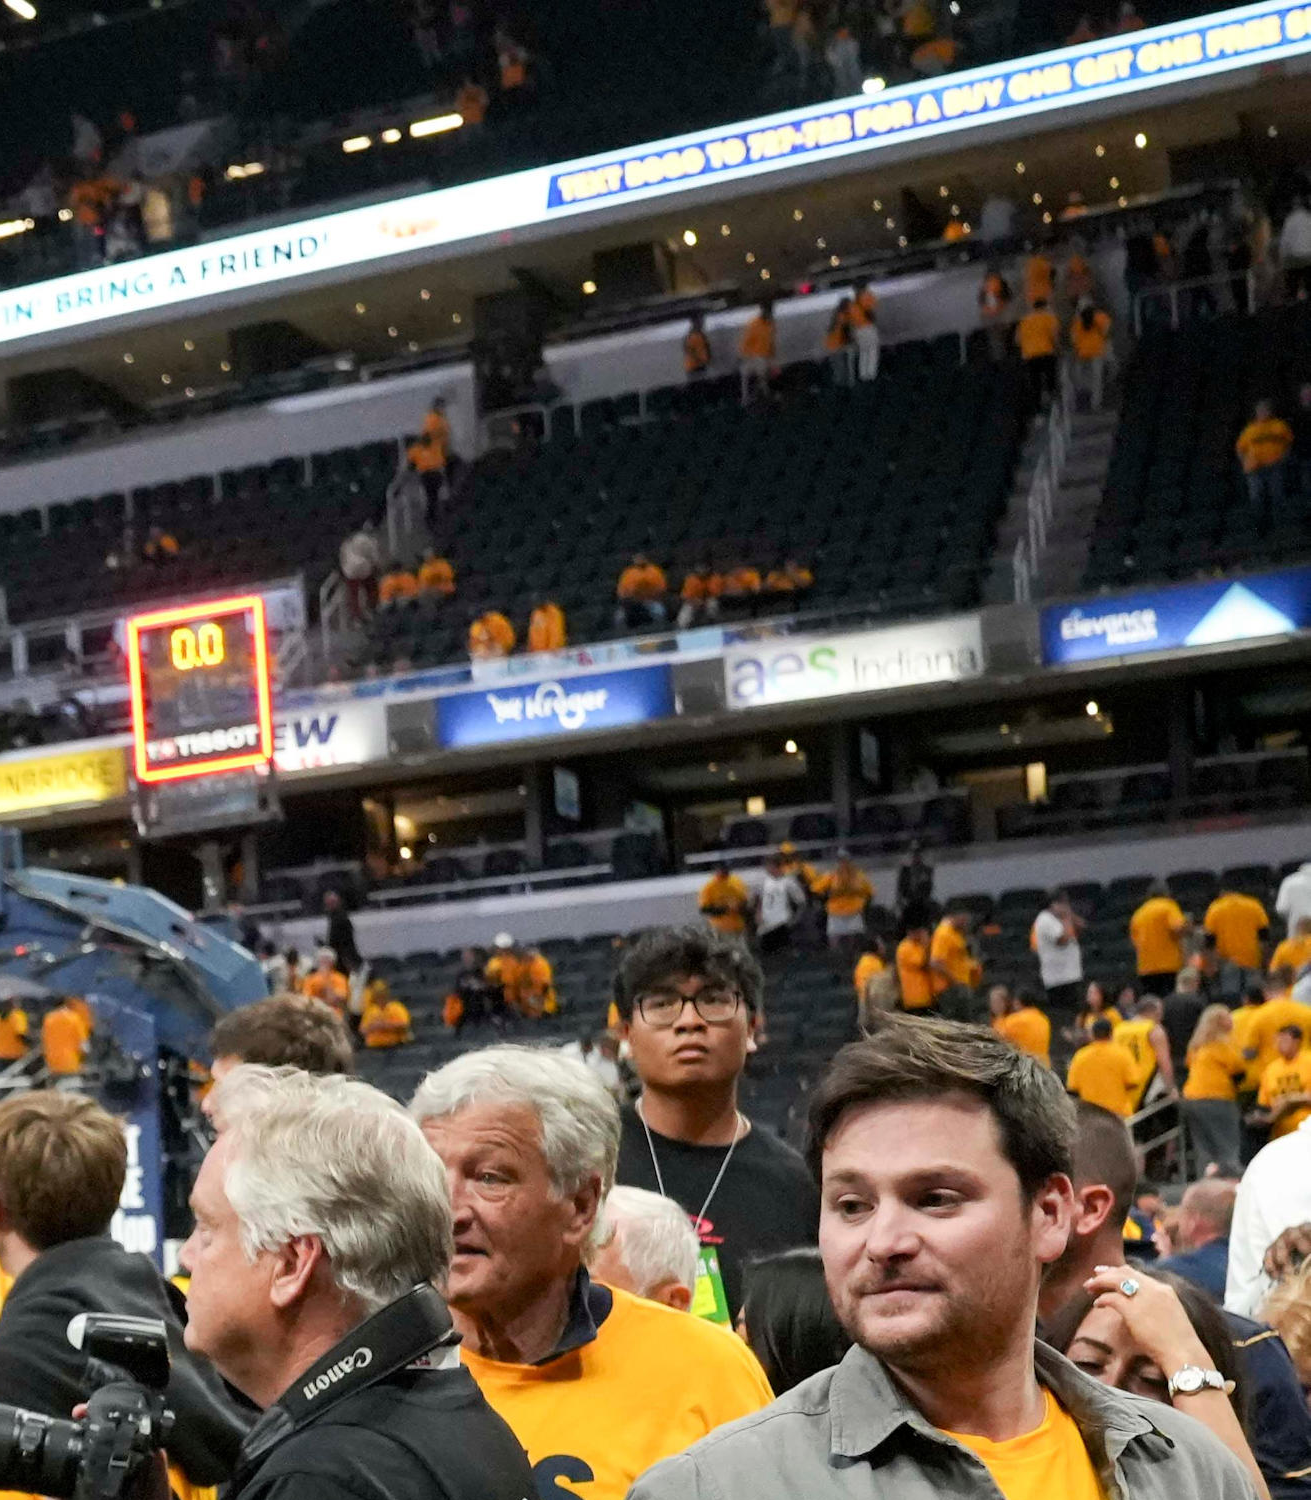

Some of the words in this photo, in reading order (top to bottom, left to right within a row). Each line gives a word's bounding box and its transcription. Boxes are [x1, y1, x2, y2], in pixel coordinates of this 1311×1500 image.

[707, 139, 746, 170] TO
[854, 101, 913, 137] FOR
[916, 94, 941, 123] A
[942, 79, 1004, 117] BUY
[1007, 63, 1072, 102] ONE
[1073, 50, 1133, 86] GET
[1136, 33, 1202, 72] ONE
[1205, 15, 1282, 58] FREE
[56, 273, 155, 314] BRING
[169, 267, 187, 288] A
[731, 647, 837, 700] aes
[852, 644, 976, 685] Indiana
[176, 723, 260, 756] TISSOT
[303, 1347, 373, 1400] Canon
